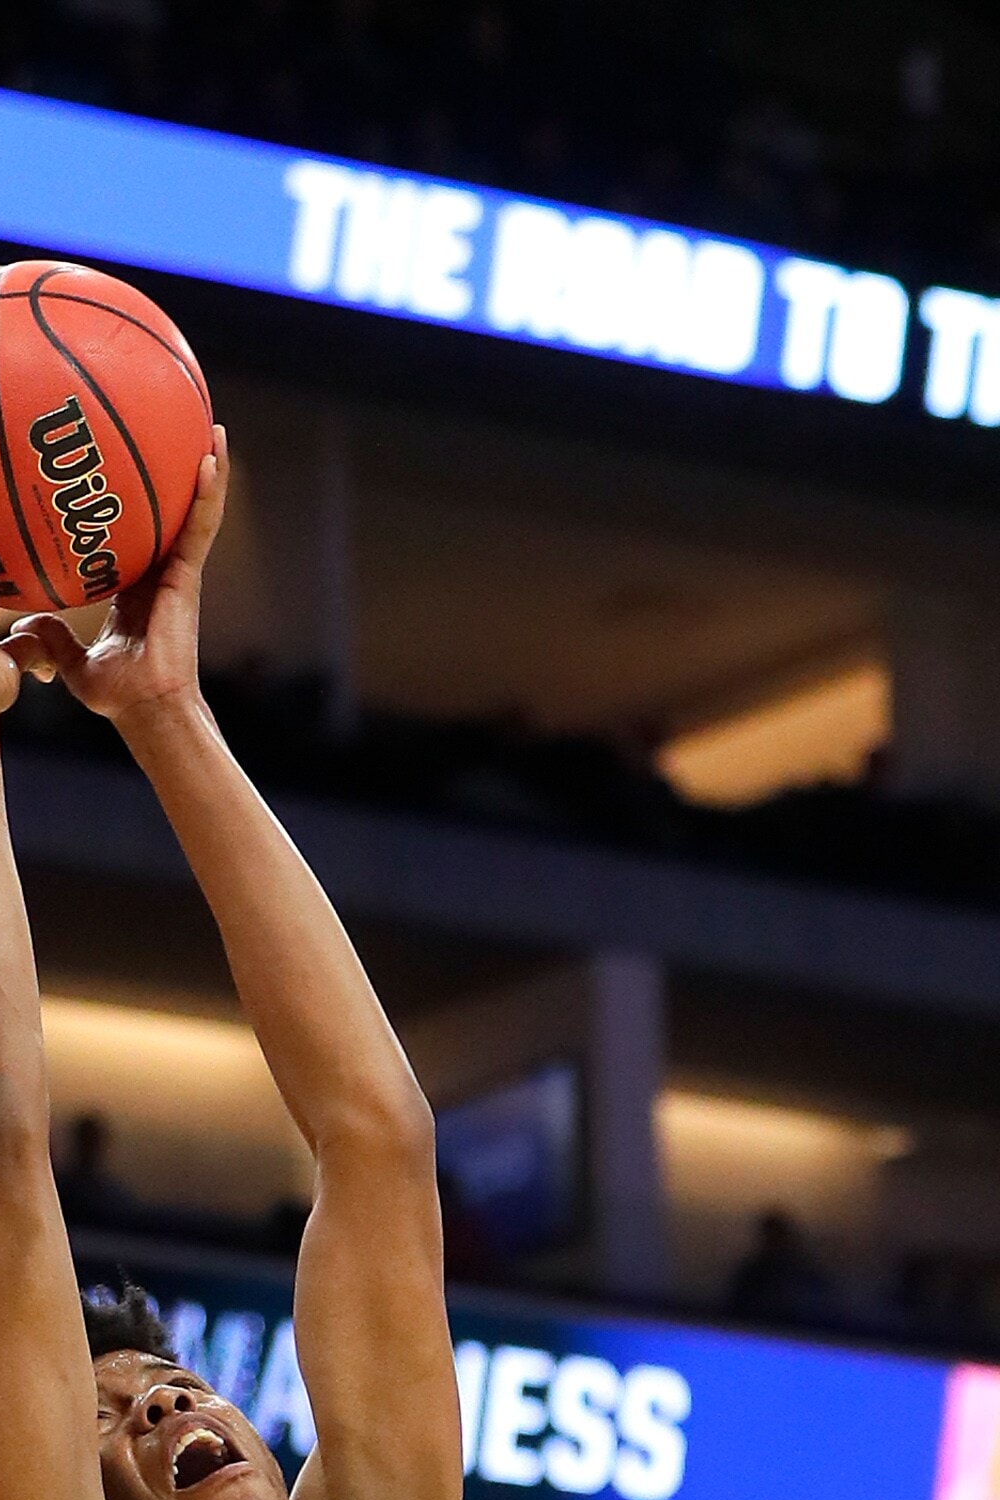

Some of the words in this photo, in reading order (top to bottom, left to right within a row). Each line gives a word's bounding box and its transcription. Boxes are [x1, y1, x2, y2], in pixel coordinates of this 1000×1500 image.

[285, 158, 482, 322] THE
[488, 201, 765, 376] ROAD
[776, 256, 910, 405] TO
[28, 394, 123, 602] Wilson
